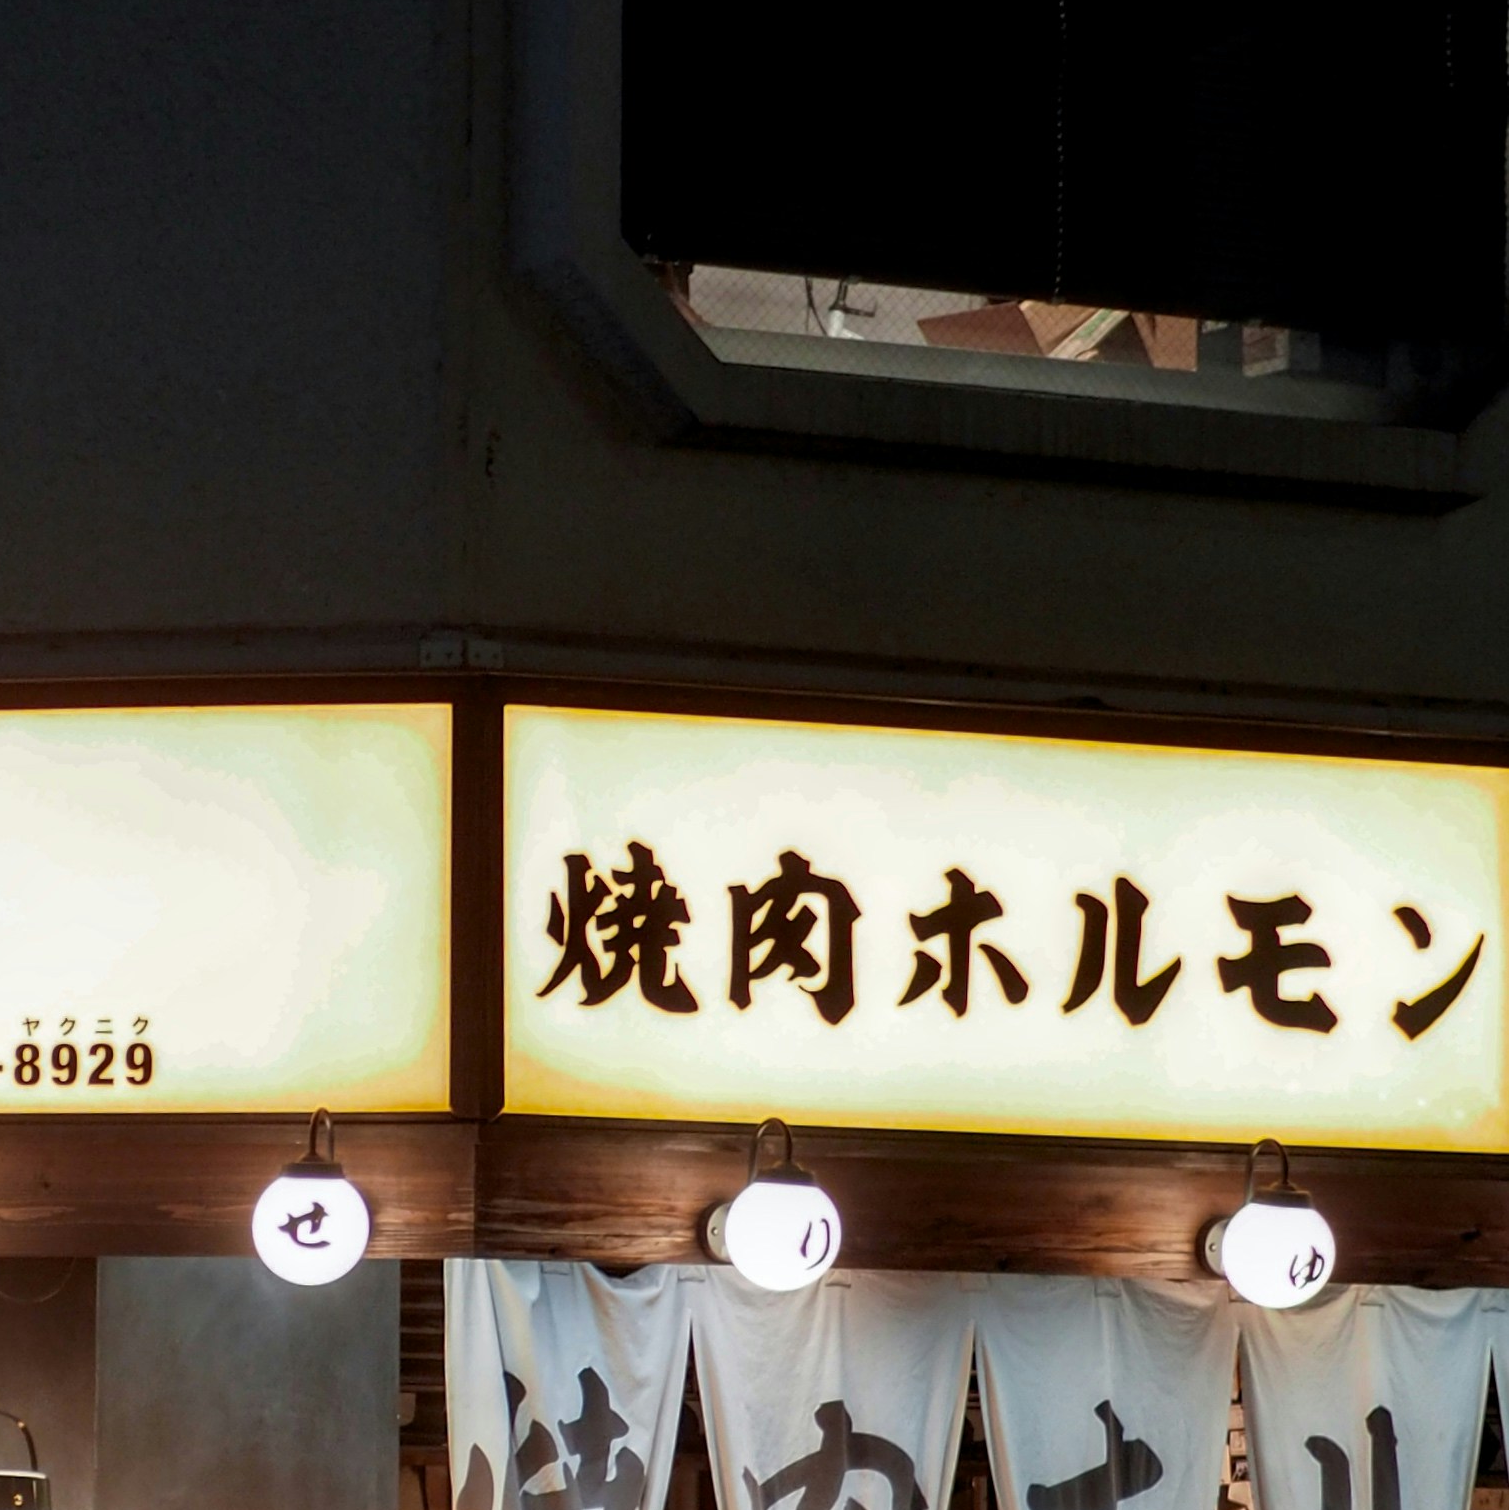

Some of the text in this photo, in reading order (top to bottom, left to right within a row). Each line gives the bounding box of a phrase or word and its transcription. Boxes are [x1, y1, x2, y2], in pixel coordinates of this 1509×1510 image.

[535, 841, 1485, 1041] 焼肉ホルモン
[22, 1016, 150, 1037] ヤクニク
